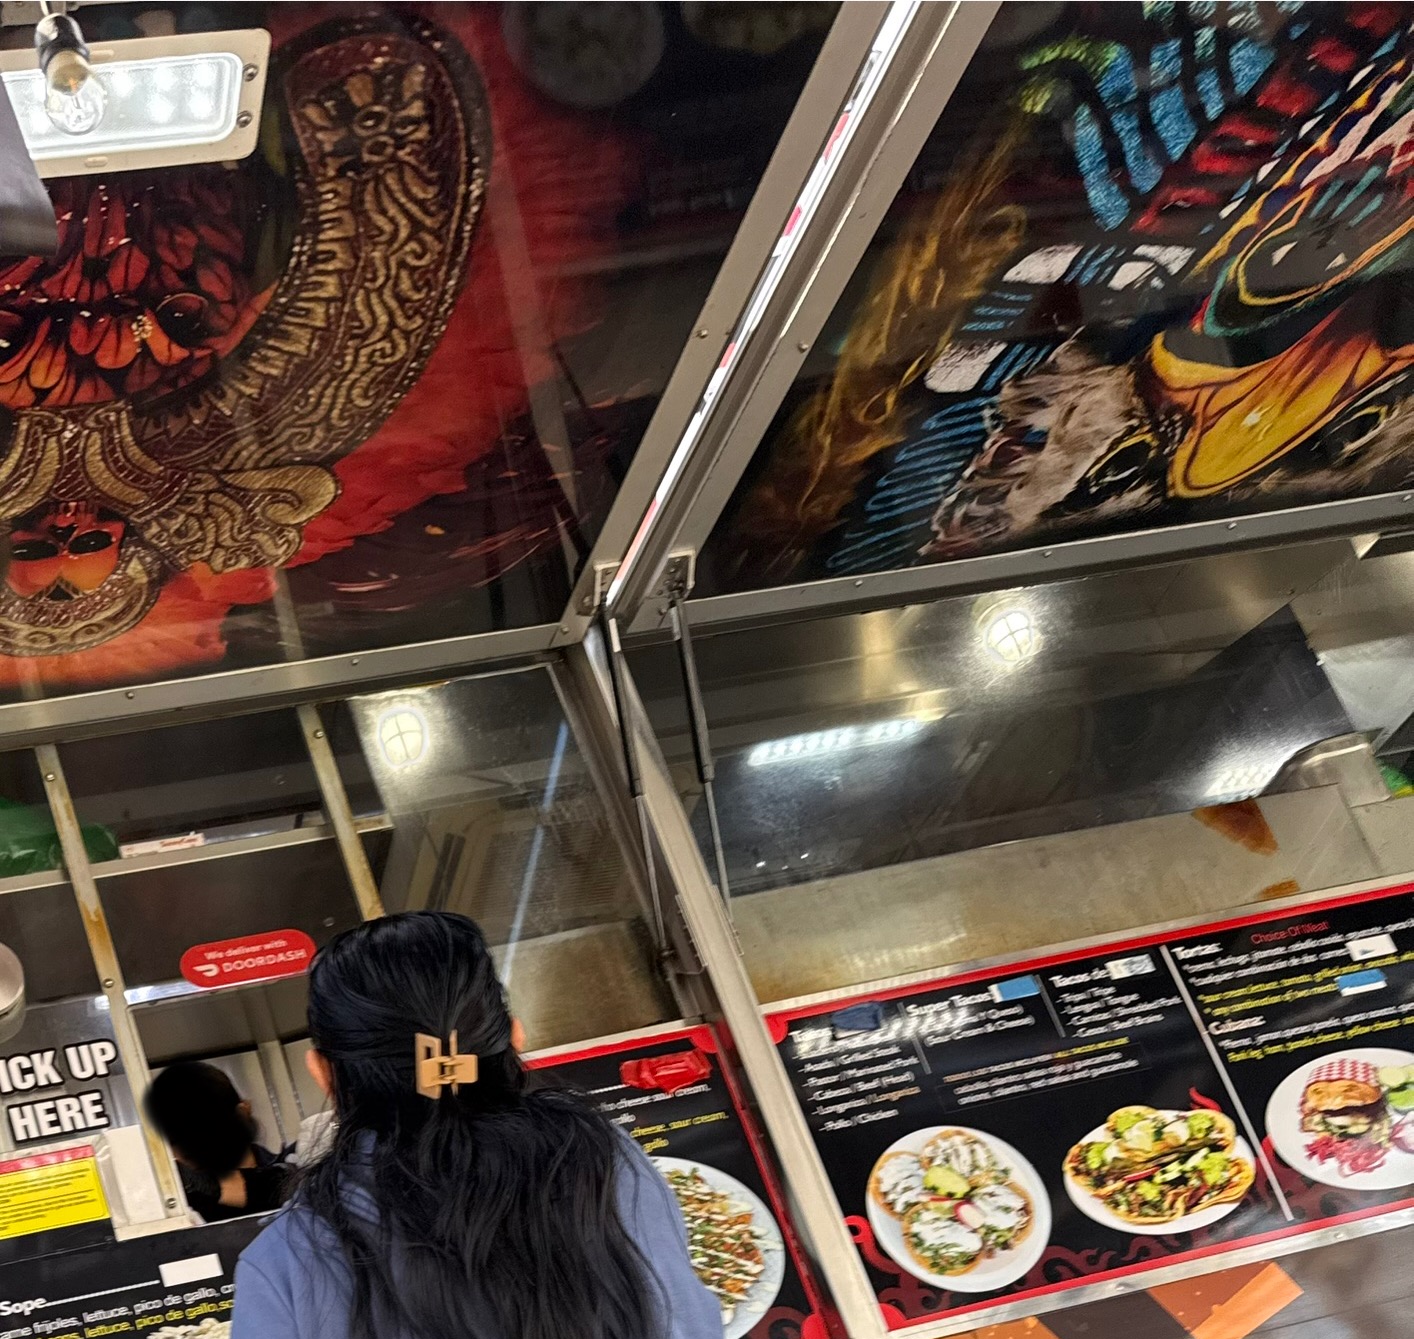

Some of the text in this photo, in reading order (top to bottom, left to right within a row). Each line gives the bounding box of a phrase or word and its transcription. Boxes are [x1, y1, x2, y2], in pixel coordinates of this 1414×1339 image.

[1251, 929, 1287, 945] Choice
[224, 944, 261, 957] deliver
[263, 939, 289, 949] with
[222, 948, 307, 973] DOORDASH
[1050, 973, 1090, 988] Tacos
[906, 999, 950, 1018] Super
[65, 1041, 117, 1079] UP
[8, 1092, 109, 1141] HERE
[0, 1297, 47, 1316] Sope
[133, 1299, 163, 1316] pico
[163, 1294, 183, 1307] de
[135, 1314, 165, 1330] pico
[165, 1309, 184, 1321] de
